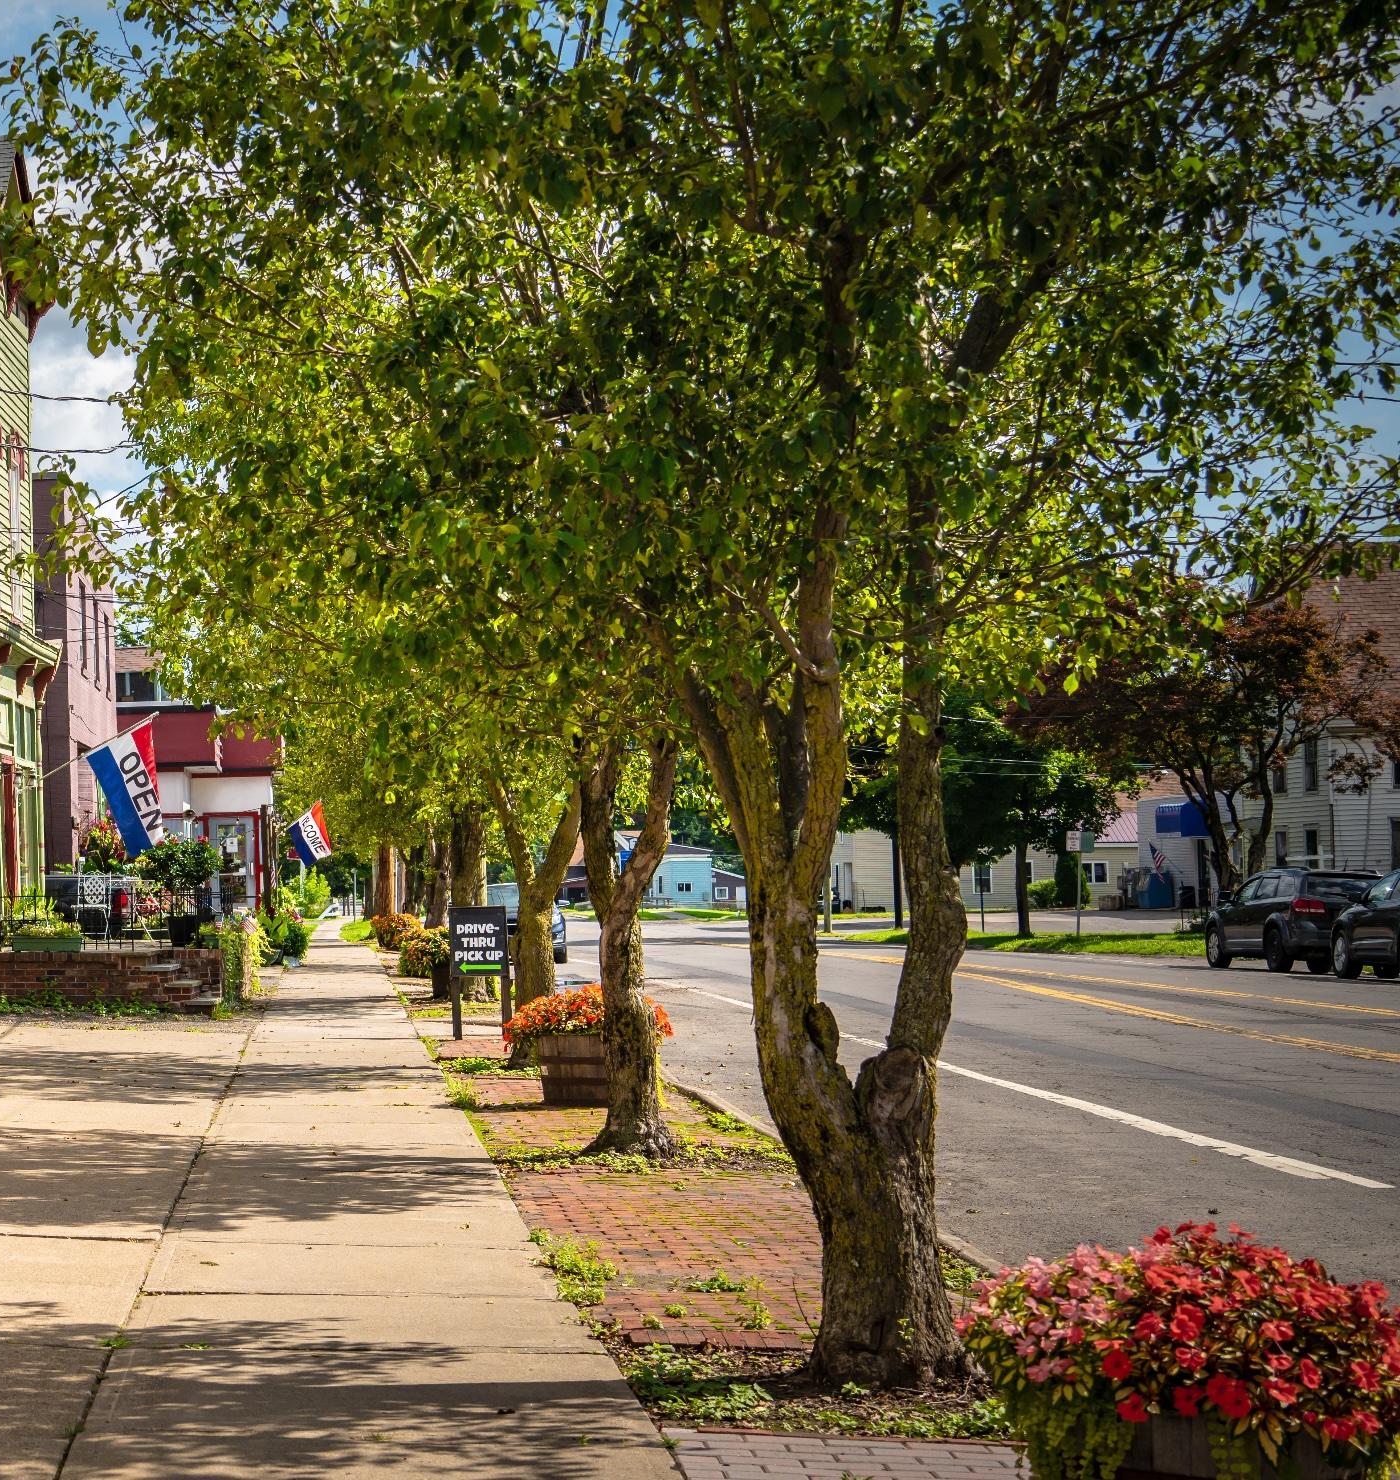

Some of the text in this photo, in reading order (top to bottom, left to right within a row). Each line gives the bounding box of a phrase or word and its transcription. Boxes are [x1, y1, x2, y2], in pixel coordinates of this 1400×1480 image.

[119, 751, 162, 832] OPEN
[456, 923, 500, 935] DRIVE-
[461, 937, 496, 948] THRU
[454, 950, 504, 962] PICK UP
